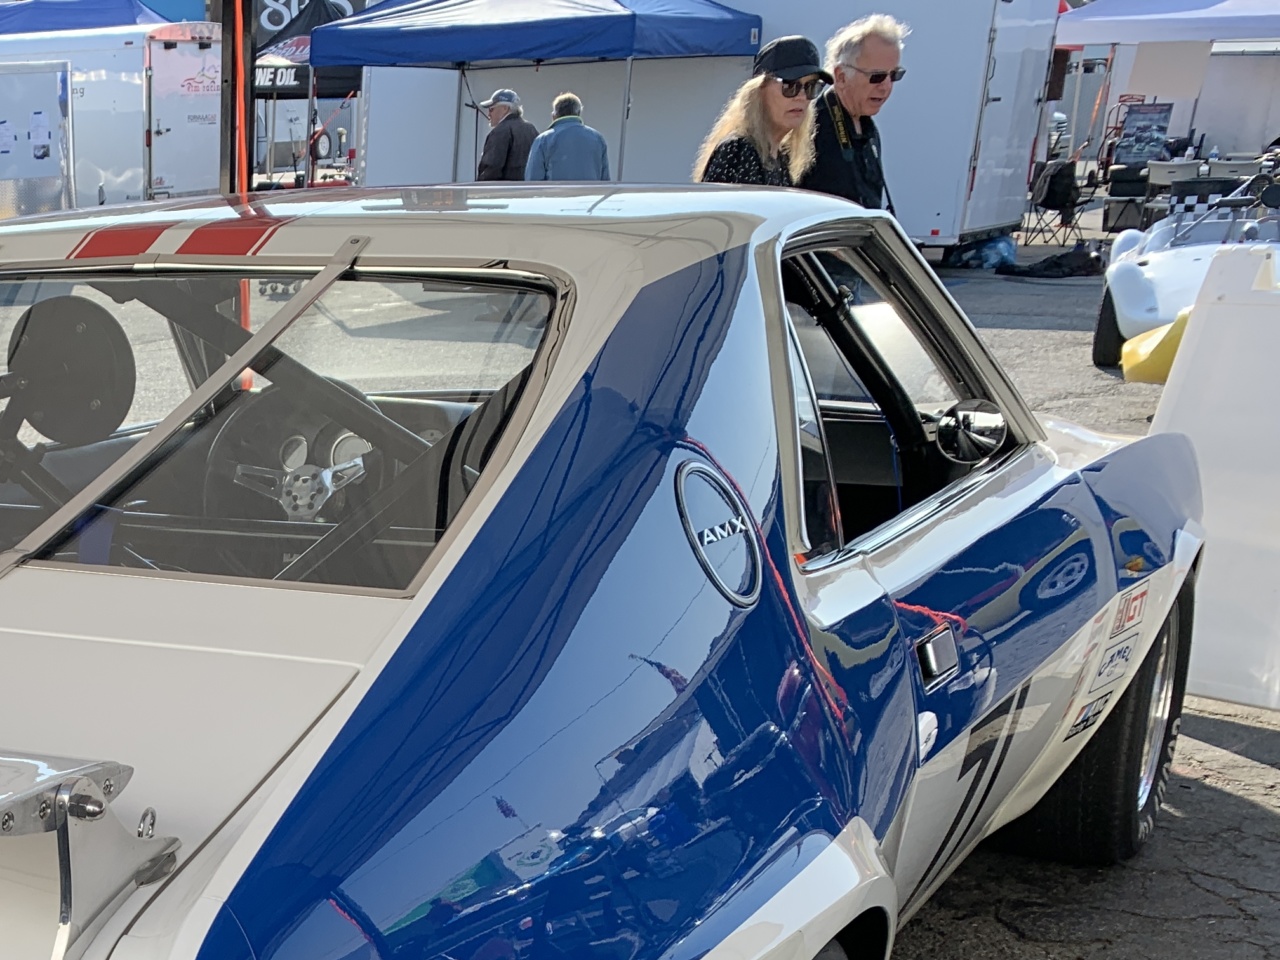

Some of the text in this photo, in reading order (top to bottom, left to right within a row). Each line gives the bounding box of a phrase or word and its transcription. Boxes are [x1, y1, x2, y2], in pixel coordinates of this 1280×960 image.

[276, 68, 298, 86] OIL
[704, 516, 746, 546] AMX
[1097, 646, 1132, 677] CAMEL
